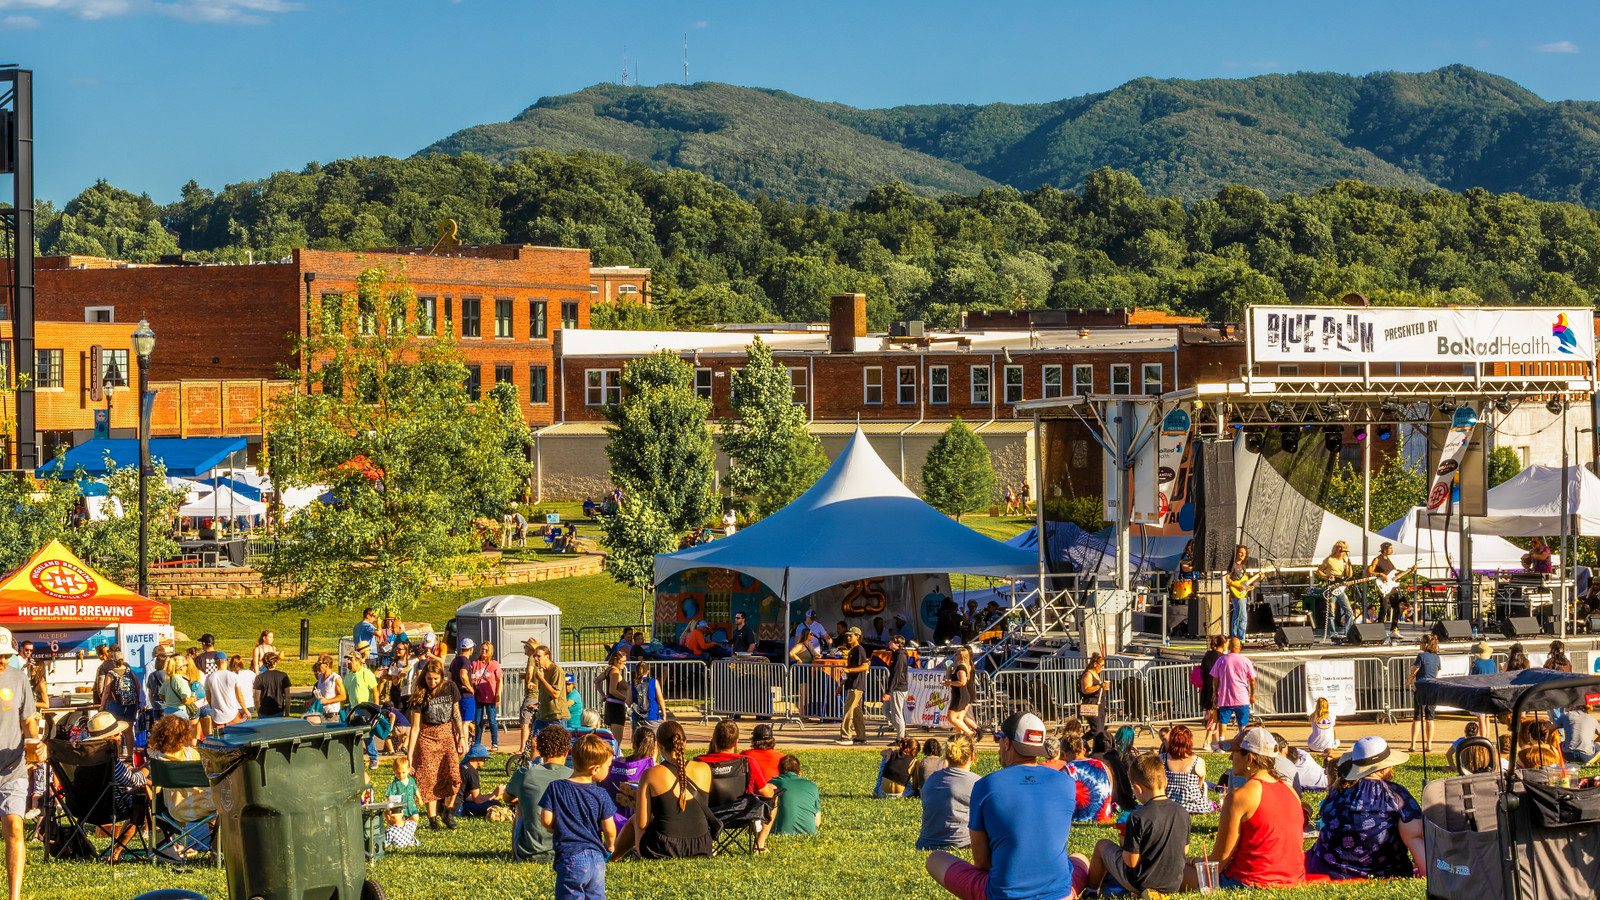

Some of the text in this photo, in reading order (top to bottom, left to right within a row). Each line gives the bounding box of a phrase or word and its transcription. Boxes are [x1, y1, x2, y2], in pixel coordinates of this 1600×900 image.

[1267, 313, 1374, 352] BLUE PLUM
[1384, 320, 1438, 341] PRESENTED BY
[31, 560, 94, 583] HIGHLAND BREWING
[841, 577, 886, 618] 25
[18, 604, 134, 617] HIGHLAND BREWING
[126, 633, 155, 644] WATER
[611, 766, 638, 775] Academy
